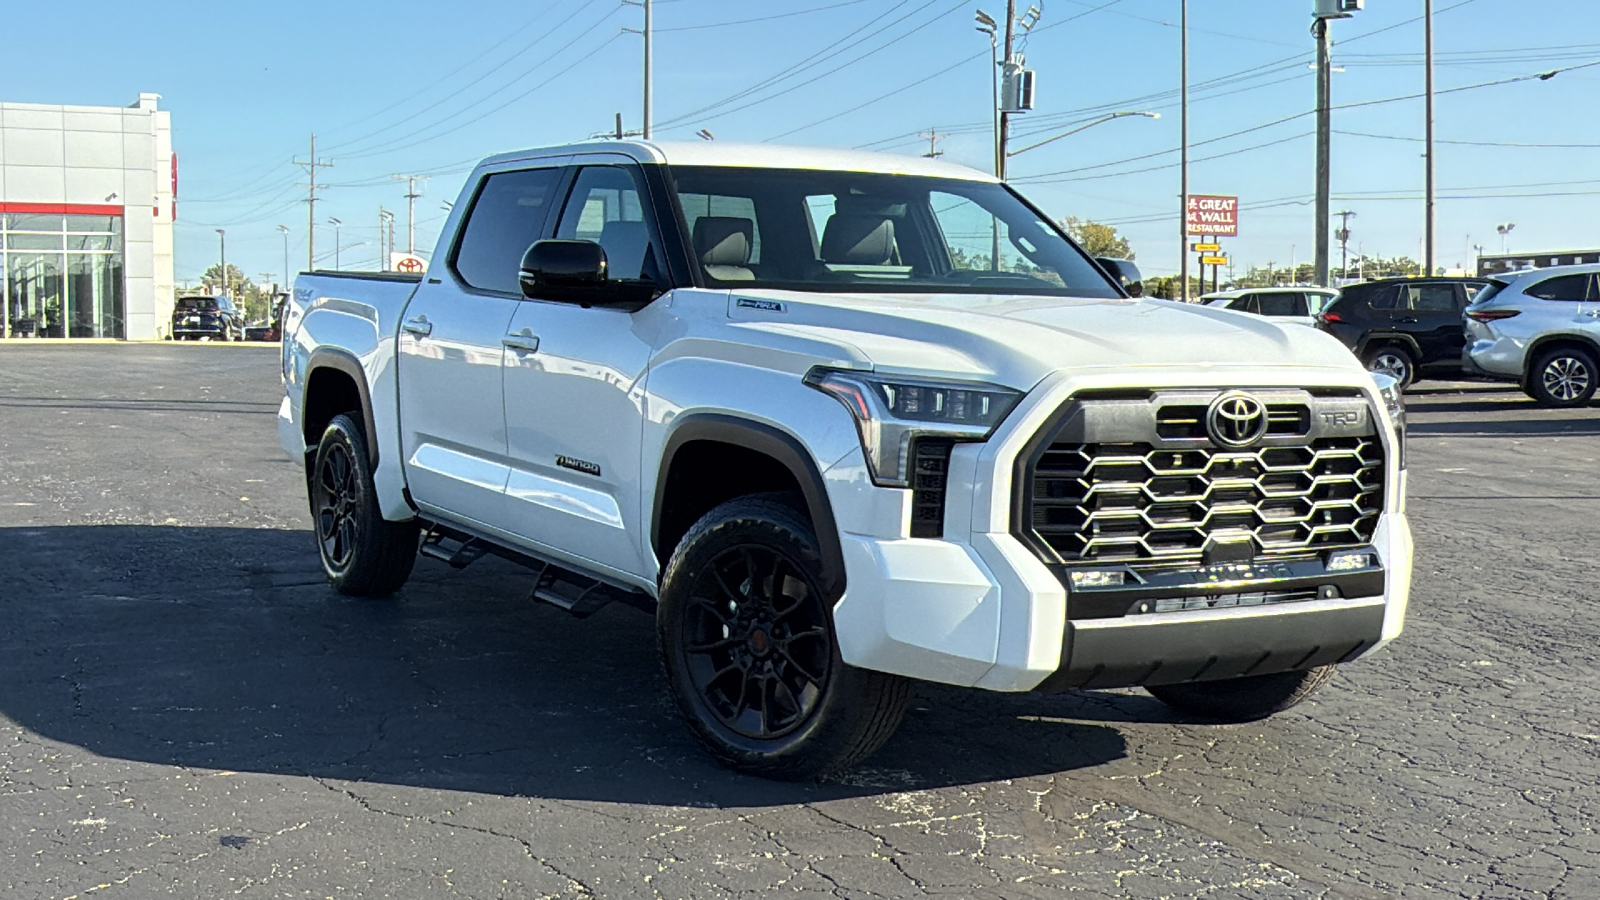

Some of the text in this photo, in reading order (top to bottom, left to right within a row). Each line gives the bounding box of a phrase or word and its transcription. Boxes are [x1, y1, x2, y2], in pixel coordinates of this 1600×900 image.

[1199, 199, 1236, 211] GREAT
[1199, 211, 1234, 223] WALL
[1320, 411, 1358, 427] TRD
